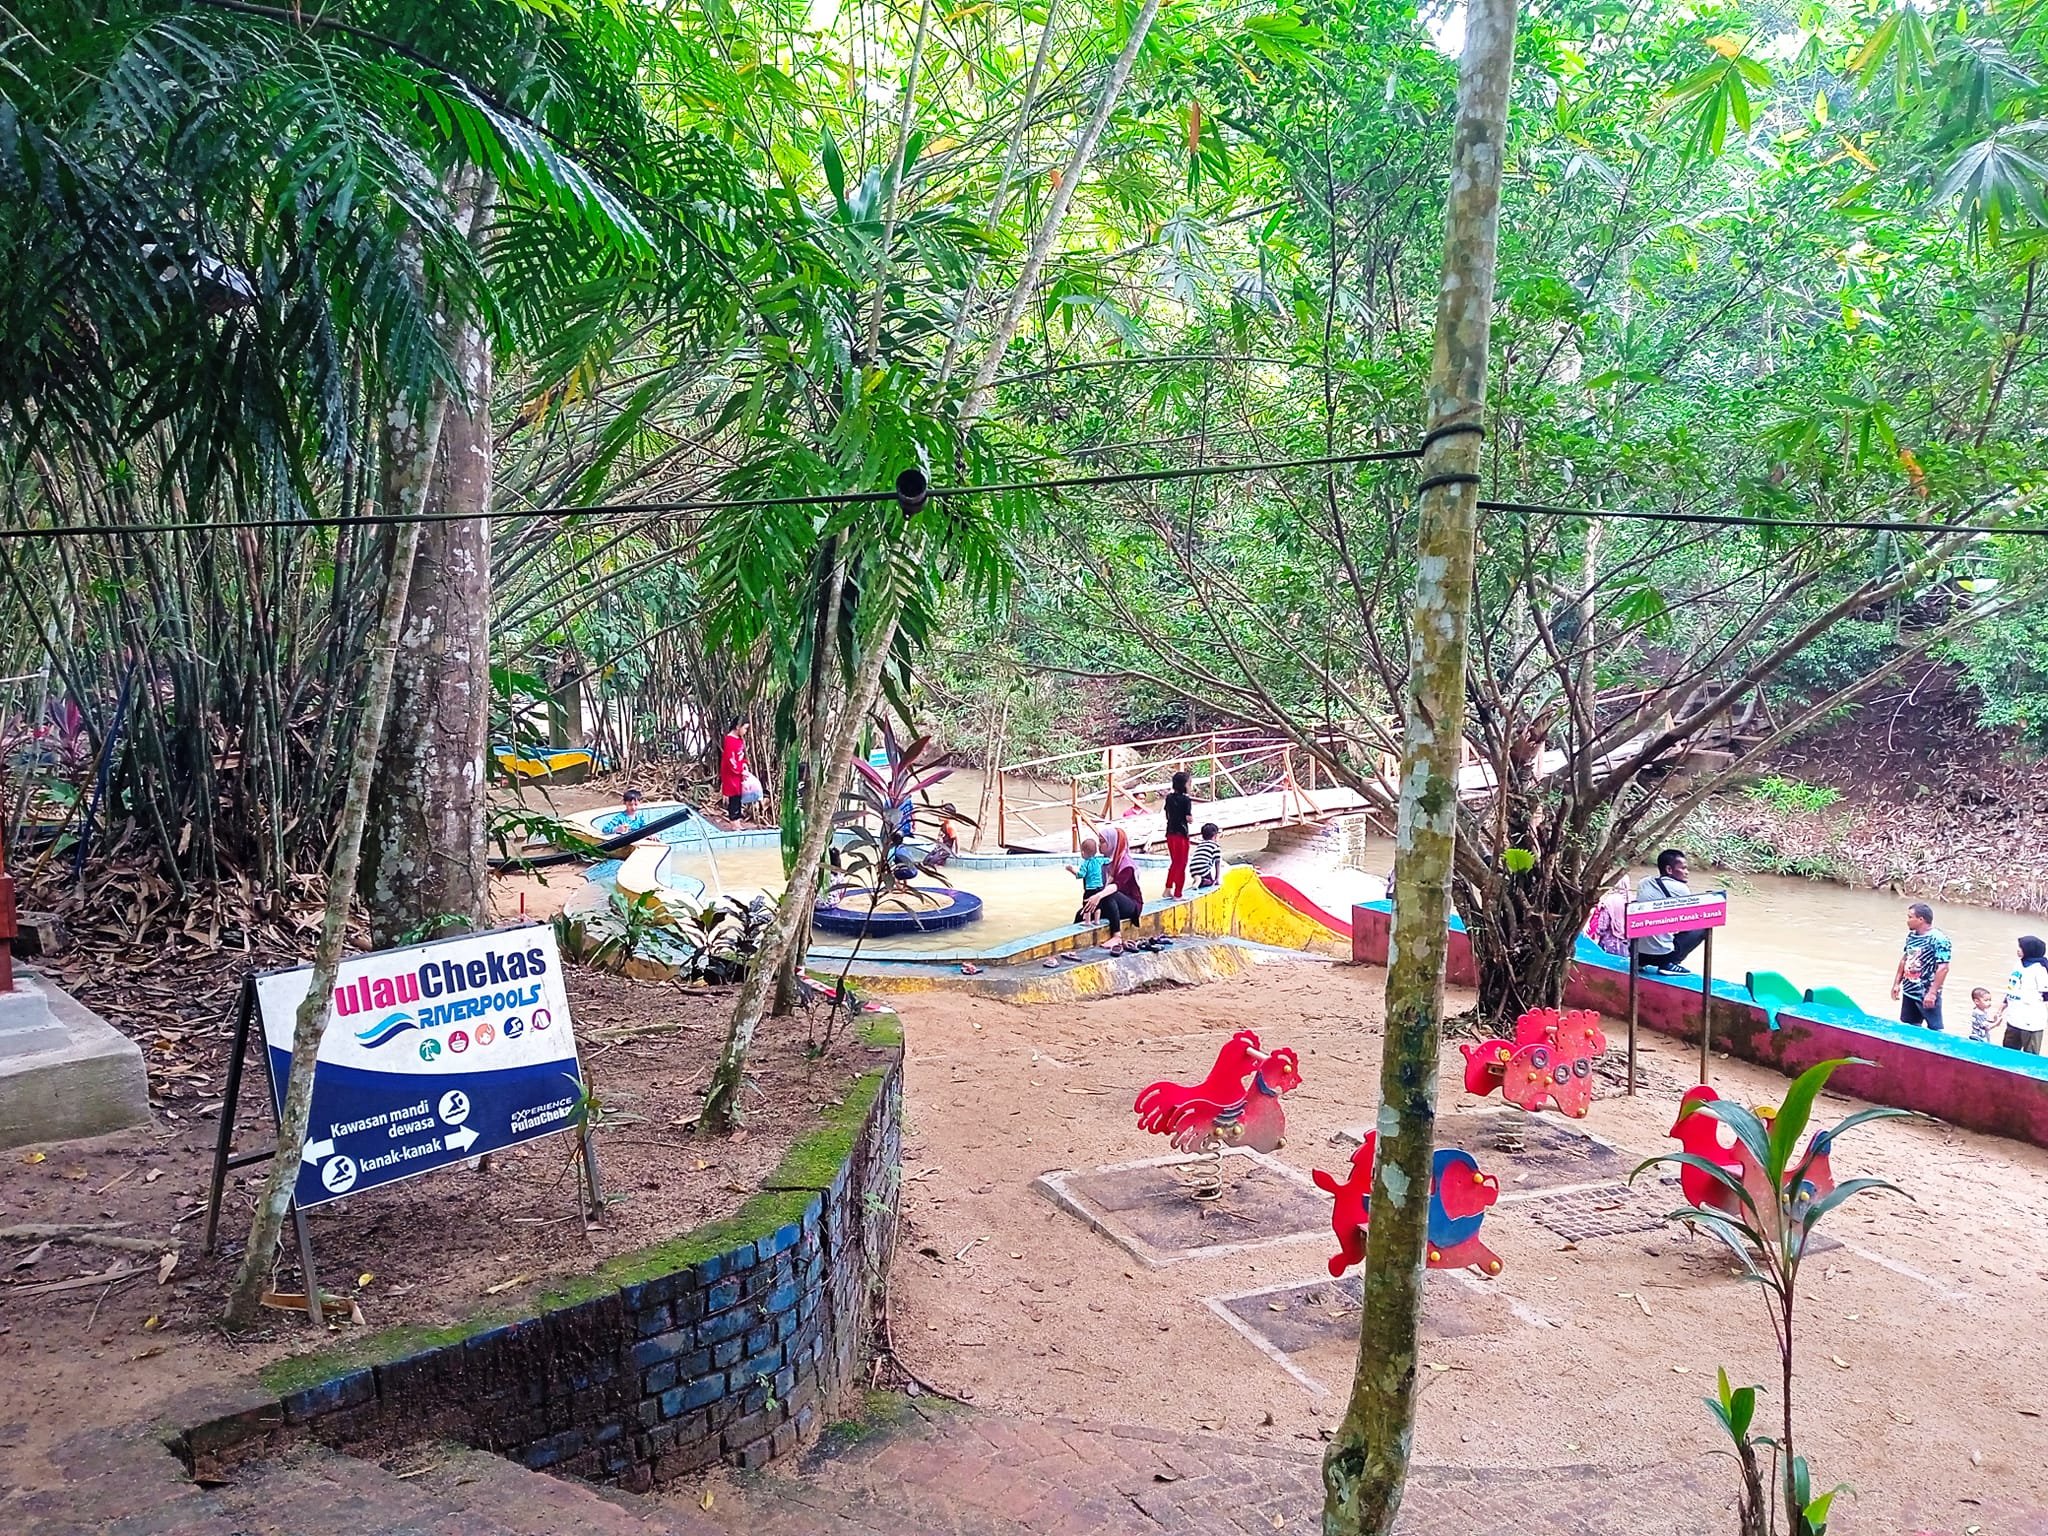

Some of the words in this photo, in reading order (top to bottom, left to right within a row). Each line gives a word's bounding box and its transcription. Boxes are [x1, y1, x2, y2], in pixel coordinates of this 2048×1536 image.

[1631, 919, 1644, 928] Zon
[1644, 916, 1679, 927] Permainan
[1679, 913, 1699, 923] Kanak
[1703, 909, 1722, 919] kanak
[334, 948, 547, 1017] ulauChekas
[418, 983, 541, 1029] RIVERPOOLS
[330, 1113, 388, 1138] Kawasan
[389, 1100, 430, 1122] mandi
[511, 1096, 572, 1121] EXPERIENCE
[511, 1104, 575, 1134] PulauCheka
[388, 1117, 435, 1138] dewasa
[360, 1138, 442, 1173] kanak-kanak
